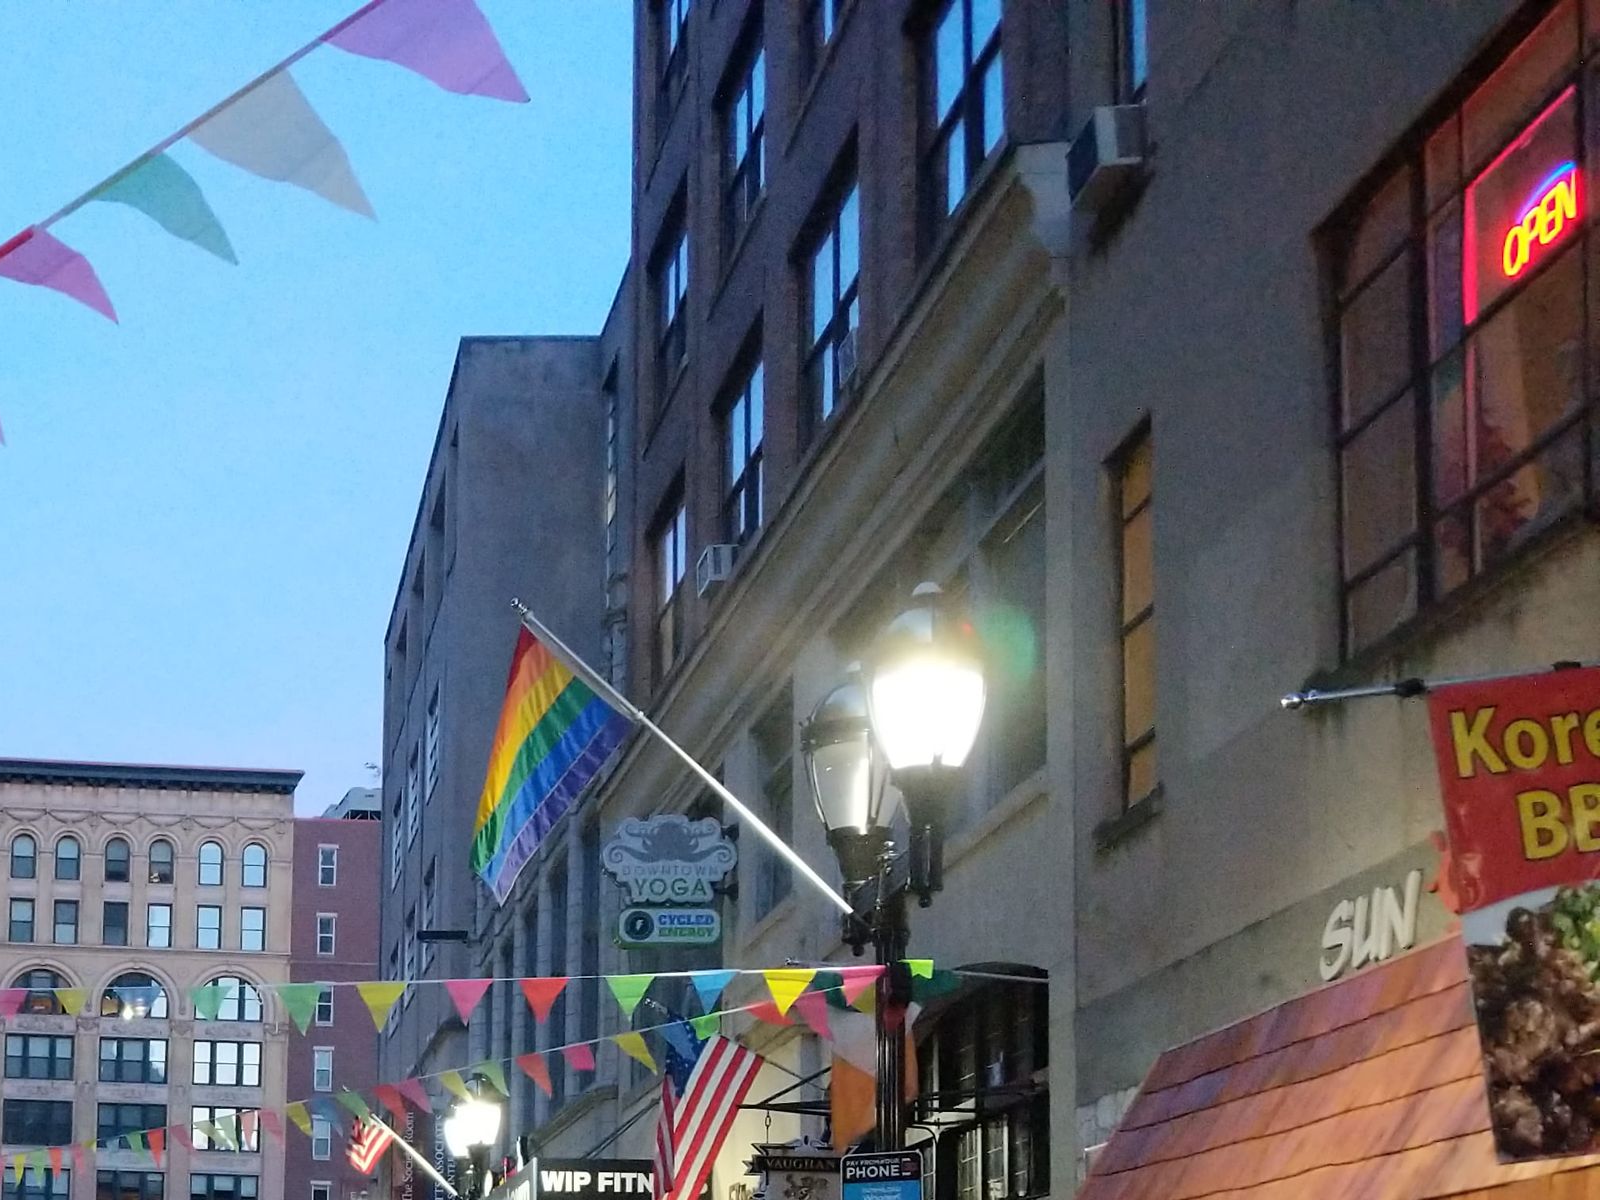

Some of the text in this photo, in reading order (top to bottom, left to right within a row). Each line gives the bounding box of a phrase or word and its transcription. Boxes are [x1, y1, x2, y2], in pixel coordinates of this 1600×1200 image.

[1503, 168, 1577, 277] OPEN
[621, 865, 720, 876] DOWNTOWN
[633, 877, 708, 896] YOGA
[1320, 870, 1423, 982] SUN
[402, 1146, 415, 1182] Socie
[846, 1165, 900, 1179] PHONE
[540, 1170, 592, 1193] WIP
